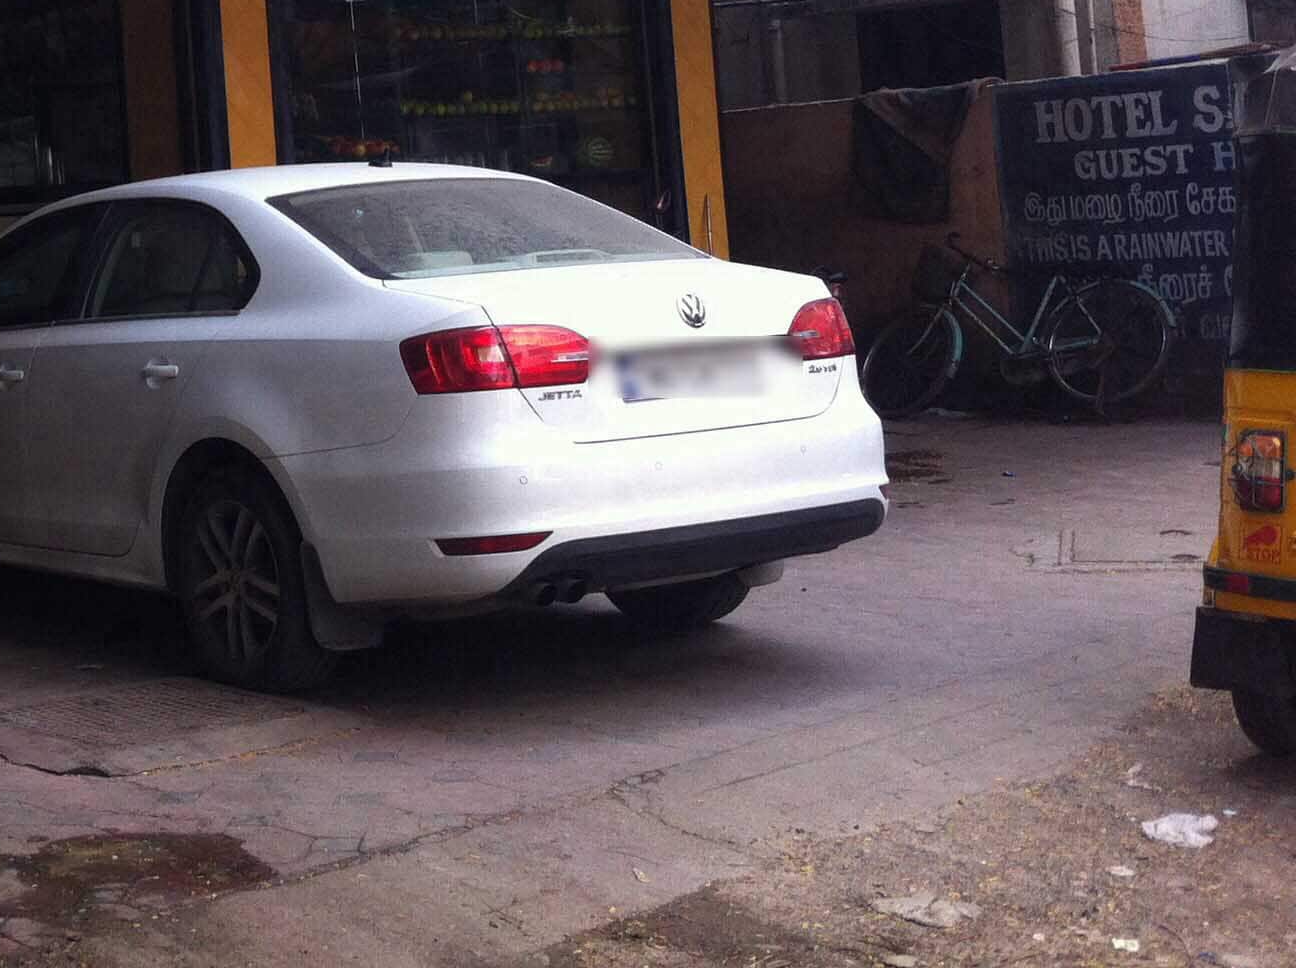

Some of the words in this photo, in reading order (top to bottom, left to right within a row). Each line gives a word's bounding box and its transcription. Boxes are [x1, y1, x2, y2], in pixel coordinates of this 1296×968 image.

[1033, 89, 1178, 144] HOTEL
[1192, 85, 1233, 133] S
[1073, 143, 1194, 181] GUEST
[537, 389, 583, 402] JETTA
